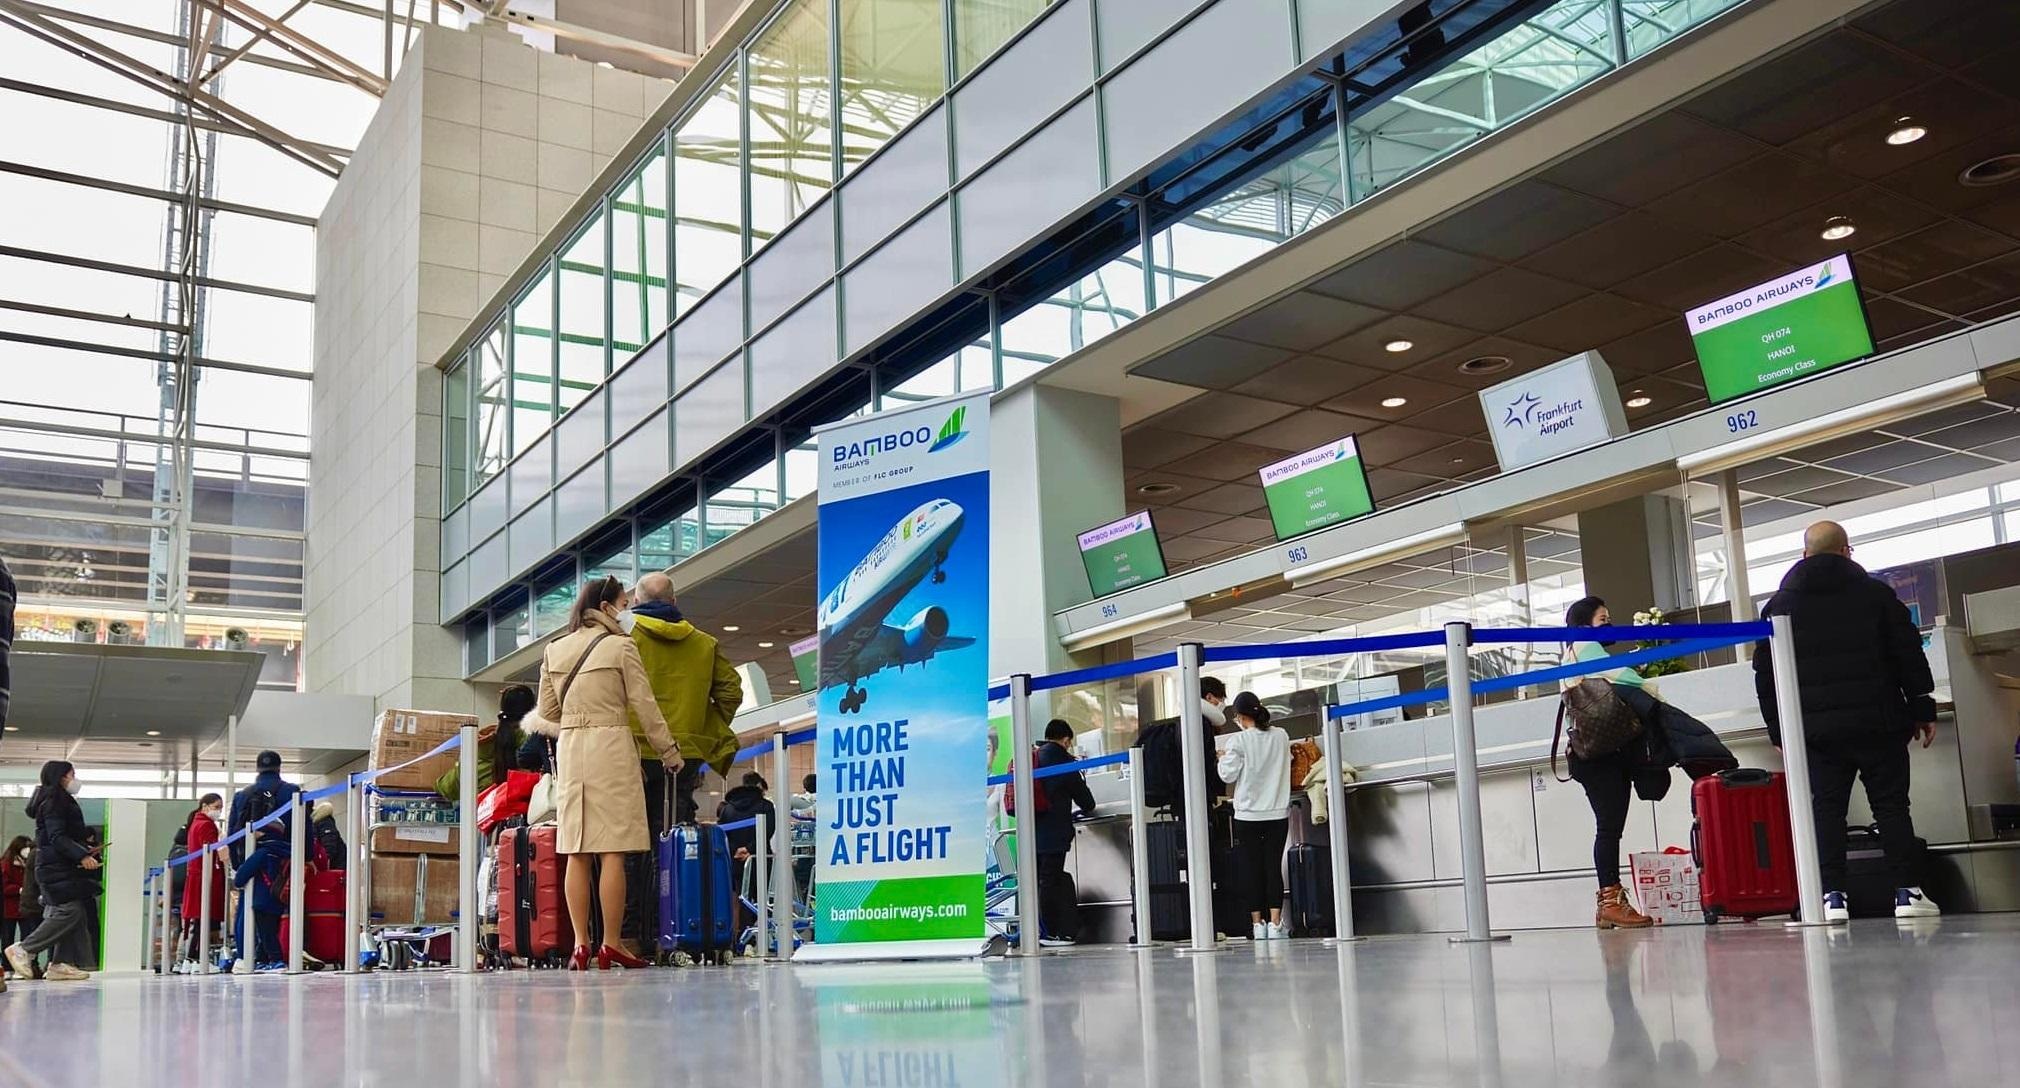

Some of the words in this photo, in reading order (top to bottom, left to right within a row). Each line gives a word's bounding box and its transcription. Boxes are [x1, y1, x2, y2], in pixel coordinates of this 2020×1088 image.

[1697, 298, 1752, 324] BAMBOO
[1756, 276, 1814, 304] AIRWAYS
[1761, 332, 1775, 343] QH
[1775, 327, 1791, 338] 074
[1767, 345, 1796, 360] HANOI
[1757, 365, 1794, 382] Economy
[1794, 359, 1817, 371] Class
[1537, 399, 1583, 422] Frankfurt
[1727, 410, 1758, 433] 962
[1540, 416, 1574, 436] Airport
[833, 427, 931, 462] BAMBOO
[834, 459, 870, 472] AIRWAYS
[873, 471, 887, 480] FLC
[888, 466, 914, 477] GROUP
[1266, 463, 1299, 480] BAMBOO
[1301, 449, 1335, 467] AIRWAYS
[1288, 546, 1308, 563] 963
[1102, 604, 1118, 617] 964
[833, 719, 909, 758] MORE
[831, 757, 905, 793] THAN
[830, 793, 898, 829] JUST
[830, 834, 850, 866] A
[856, 826, 952, 864] FLIGHT
[830, 903, 967, 922] bambooairways.com
